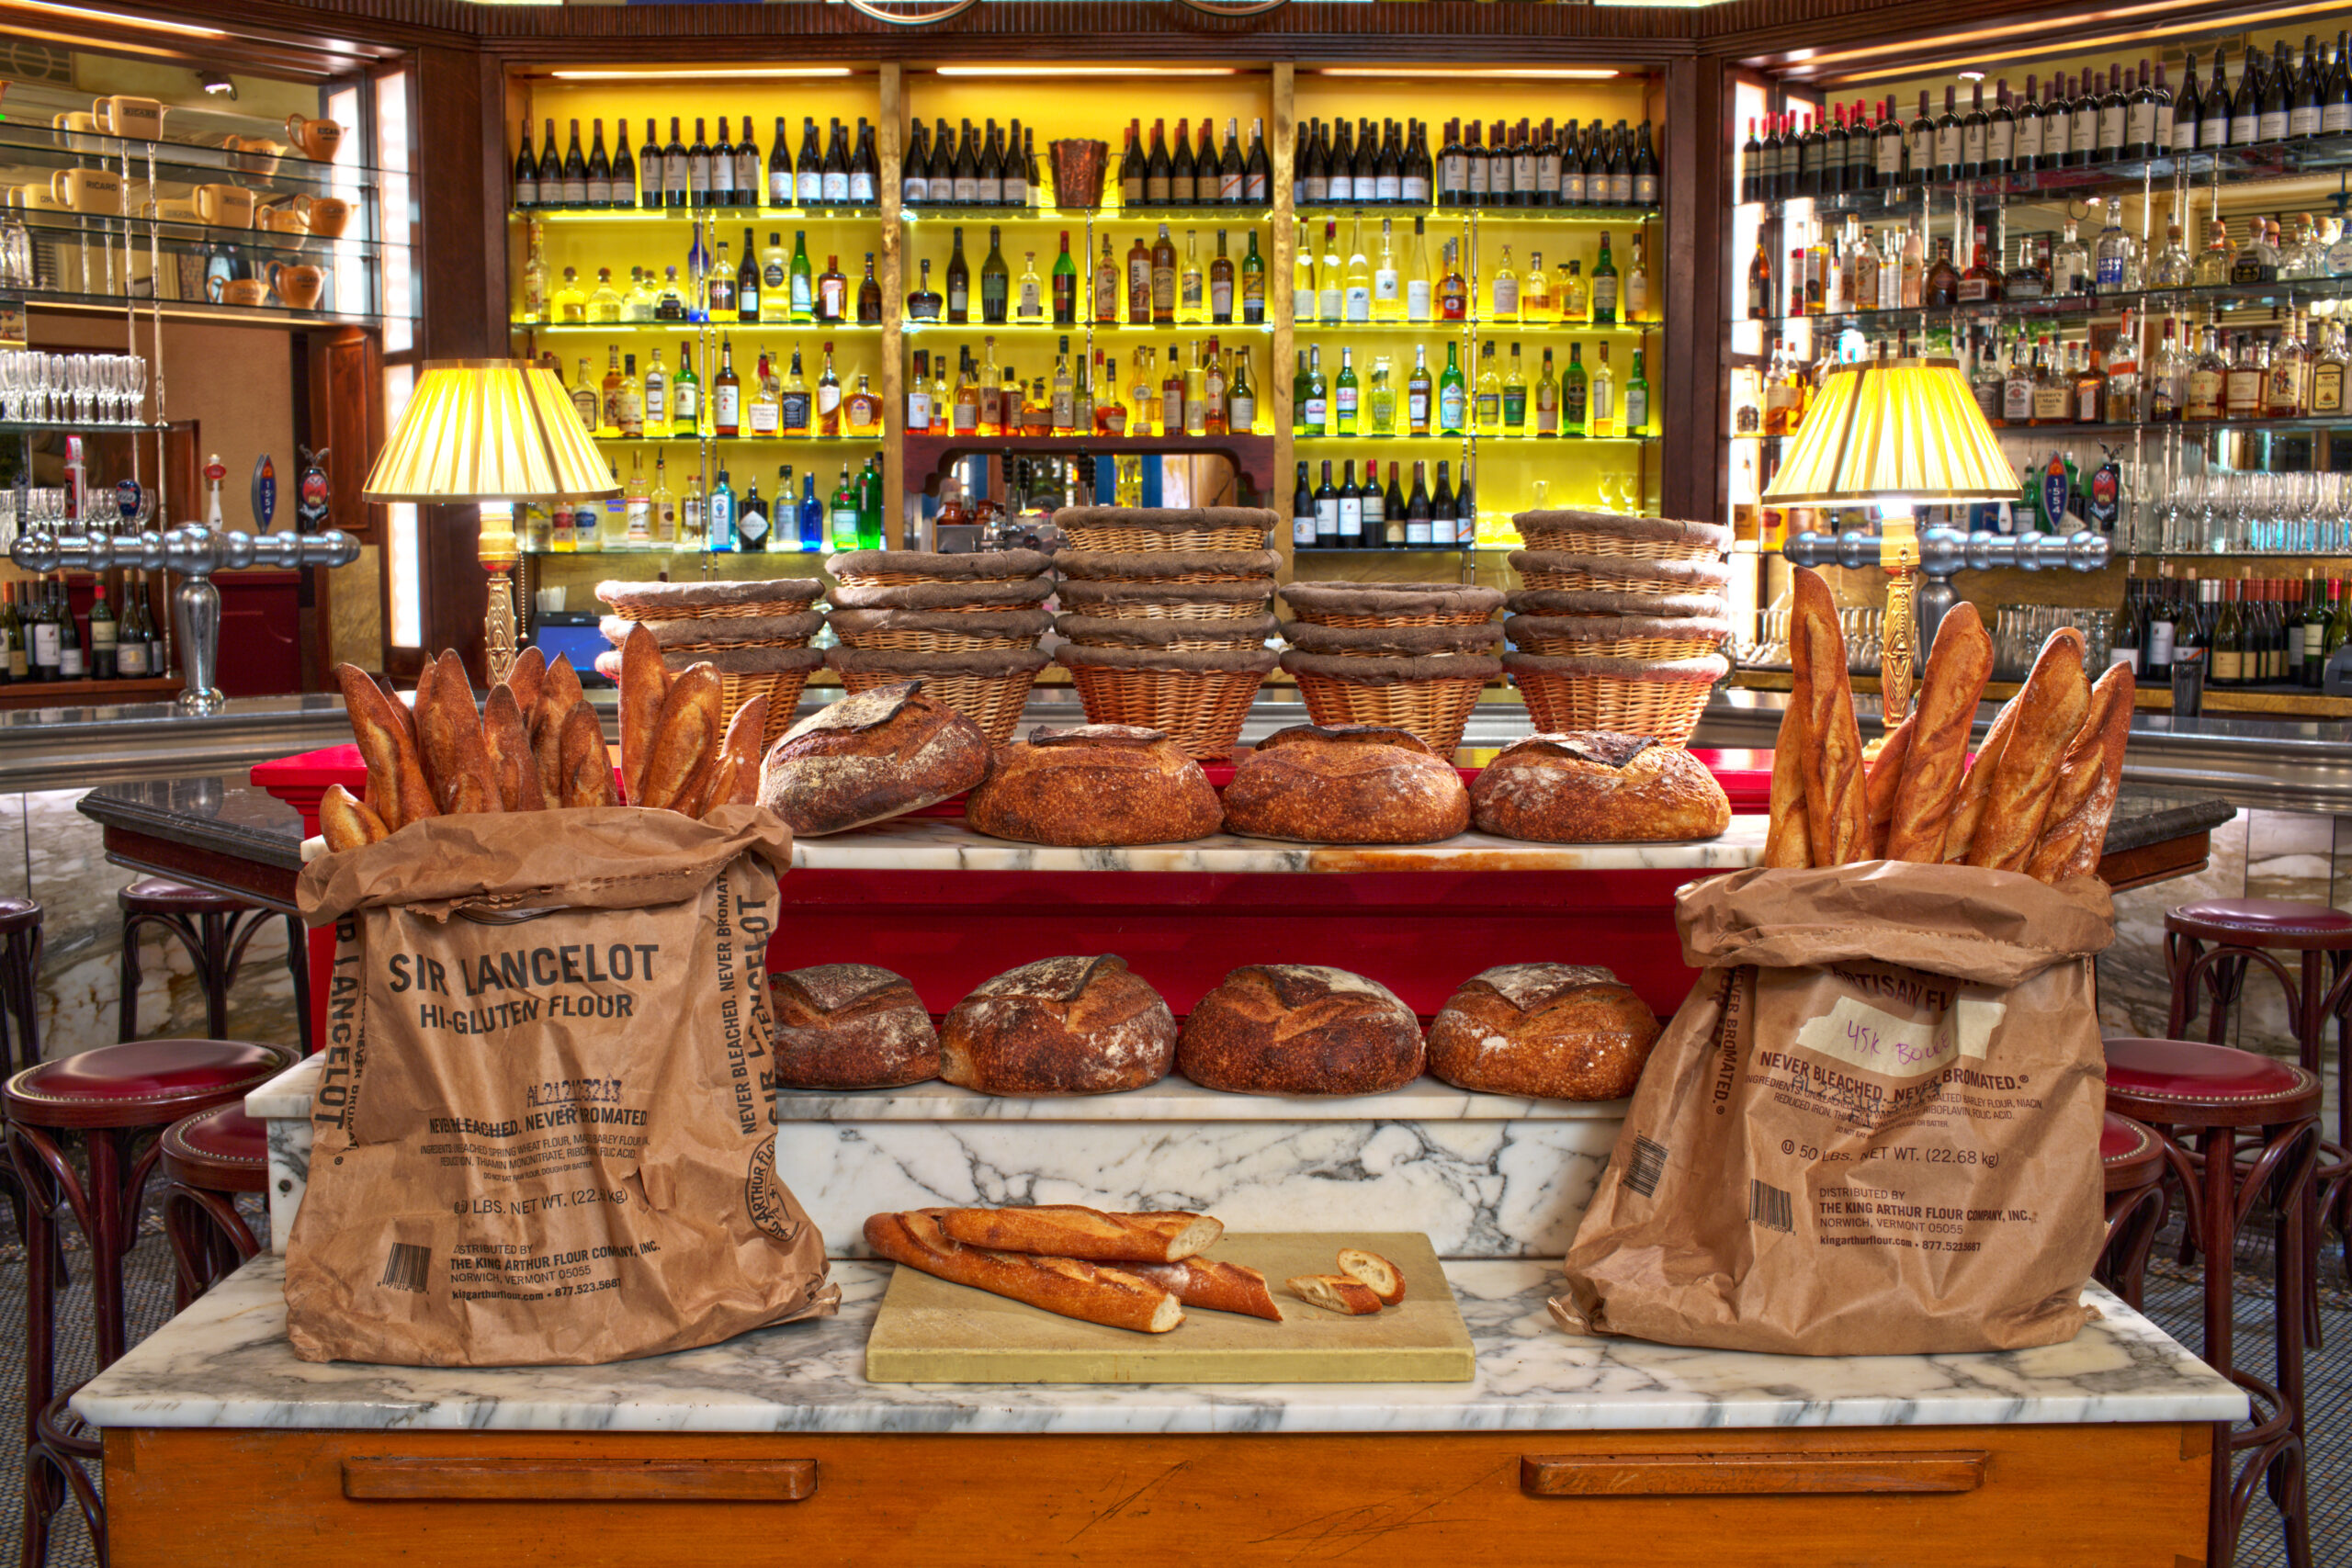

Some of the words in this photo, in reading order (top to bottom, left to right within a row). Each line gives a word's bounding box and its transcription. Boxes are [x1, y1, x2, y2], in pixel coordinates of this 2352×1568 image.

[86, 181, 118, 191] RICARD
[264, 480, 272, 514] 1554
[2052, 478, 2061, 513] 1554
[389, 953, 448, 997] SIR
[461, 943, 660, 998] LANCELOT
[717, 942, 736, 993] NEVER
[420, 998, 540, 1035] HI-GLUTEN
[548, 994, 634, 1019] FLOUR
[314, 955, 359, 1130] LANCELOT
[721, 995, 749, 1079] BLEACHED.
[1759, 1051, 1810, 1077] NEVER
[1813, 1065, 1887, 1102] BLEACHED.
[1894, 1076, 1940, 1103] NEVER
[735, 1081, 758, 1135] NEVER
[1773, 1092, 1811, 1111] REDUCED
[1993, 1110, 2015, 1121] ACID.
[526, 1108, 577, 1132] NEVER
[543, 1135, 572, 1149] FLOUR,
[477, 1156, 507, 1169] THIAMIN
[1799, 1145, 1818, 1160] 50
[1821, 1150, 1854, 1162] LBS.
[1860, 1146, 1890, 1161] NET
[1894, 1146, 1920, 1161] WT.
[1925, 1147, 1978, 1165] (22.68
[1981, 1151, 2000, 1168] kg)
[472, 1200, 506, 1214] LBS.
[510, 1198, 537, 1214] NET
[541, 1193, 568, 1210] WT.
[750, 1166, 772, 1224] ARTHUR
[1819, 1188, 1888, 1200] DISTRIBUTED
[1891, 1190, 1906, 1201] BY
[1819, 1201, 1842, 1214] THE
[1845, 1201, 1873, 1214] KING
[1876, 1203, 1922, 1219] ARTHUR
[1926, 1206, 1963, 1221] FLOUR
[1966, 1209, 2006, 1223] COMPANY,
[2007, 1210, 2031, 1222] INC.
[1819, 1217, 1874, 1229] NORWICH,
[1876, 1218, 1926, 1233] VERMONT
[1928, 1223, 1964, 1235] 05055
[519, 1245, 534, 1256] BY
[1819, 1235, 1913, 1247] kingarthurflour.com
[450, 1258, 472, 1270] THE
[475, 1257, 502, 1270] KING
[504, 1256, 550, 1272] ARTHUR
[553, 1249, 590, 1267] FLOUR
[639, 1240, 661, 1255] INC.
[450, 1272, 503, 1285] NORWICH,
[503, 1270, 556, 1286] VERMONT
[558, 1265, 592, 1280] 05055
